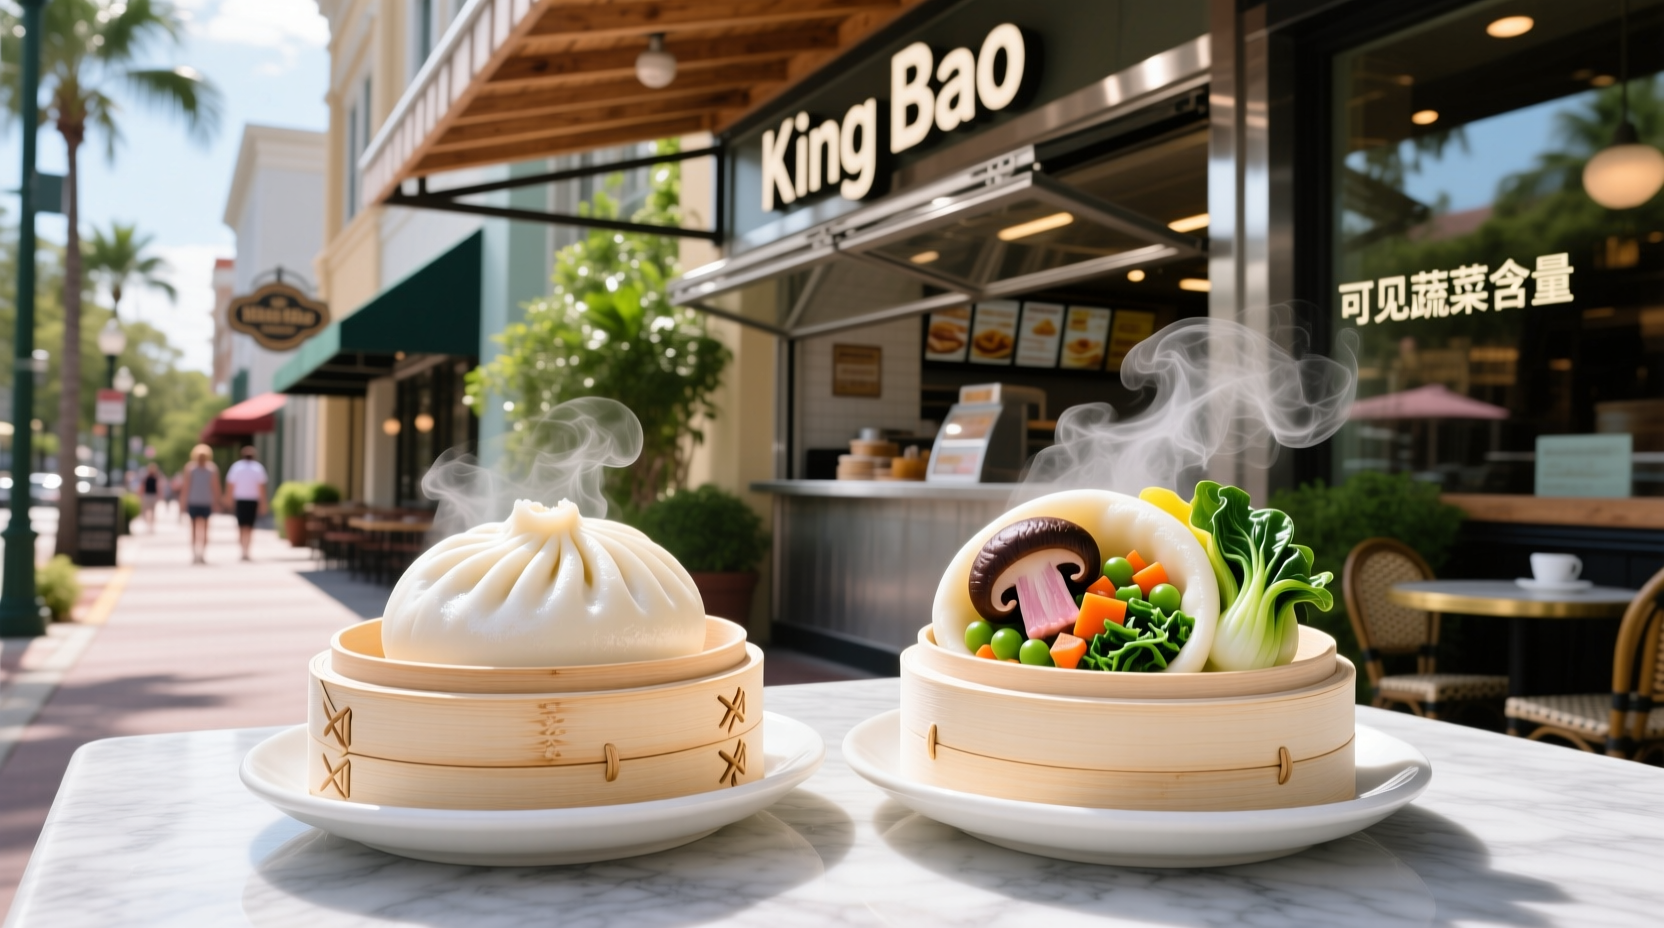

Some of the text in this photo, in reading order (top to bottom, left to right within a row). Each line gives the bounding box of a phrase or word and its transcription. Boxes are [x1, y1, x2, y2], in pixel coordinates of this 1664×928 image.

[762, 23, 1025, 213] King Bao
[1338, 252, 1574, 326] 可见蔬菜含量
